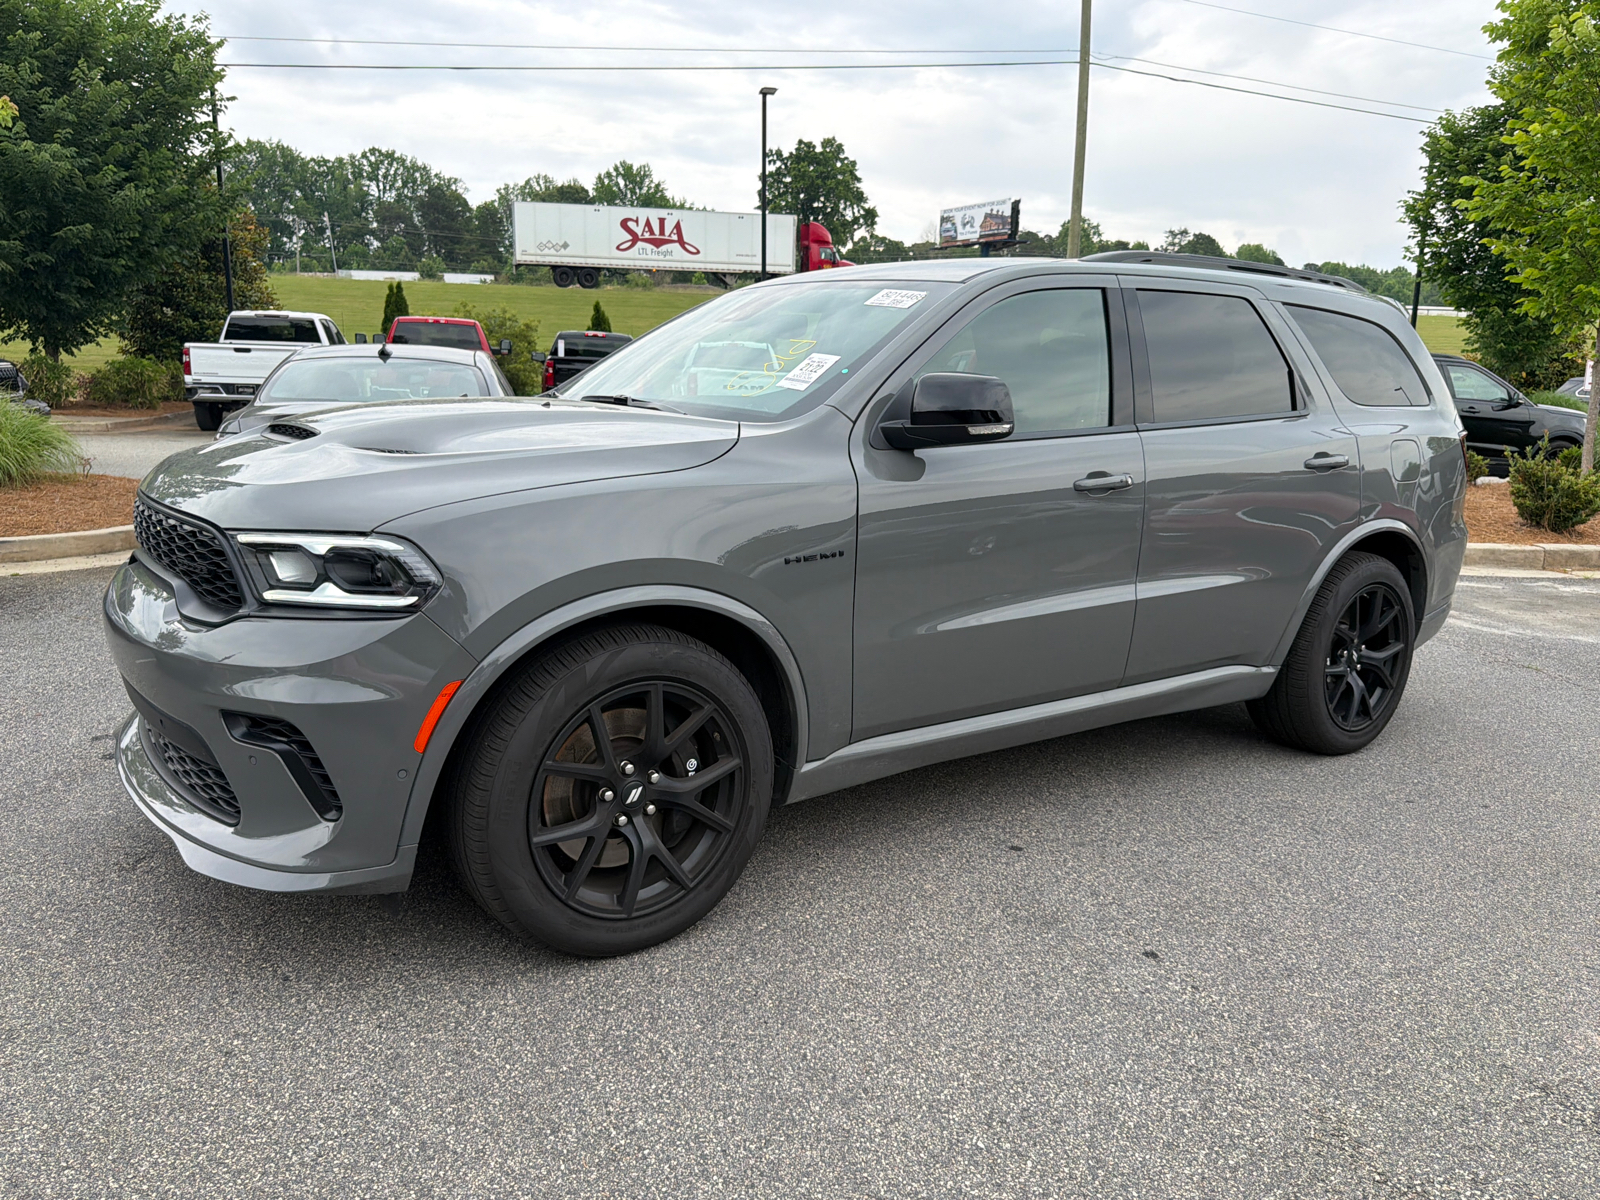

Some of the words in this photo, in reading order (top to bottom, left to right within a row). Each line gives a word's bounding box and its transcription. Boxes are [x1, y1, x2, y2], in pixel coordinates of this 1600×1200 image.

[616, 216, 701, 256] SAIA
[638, 247, 649, 256] LTL
[651, 248, 674, 259] Freight
[784, 550, 845, 565] HEMI
